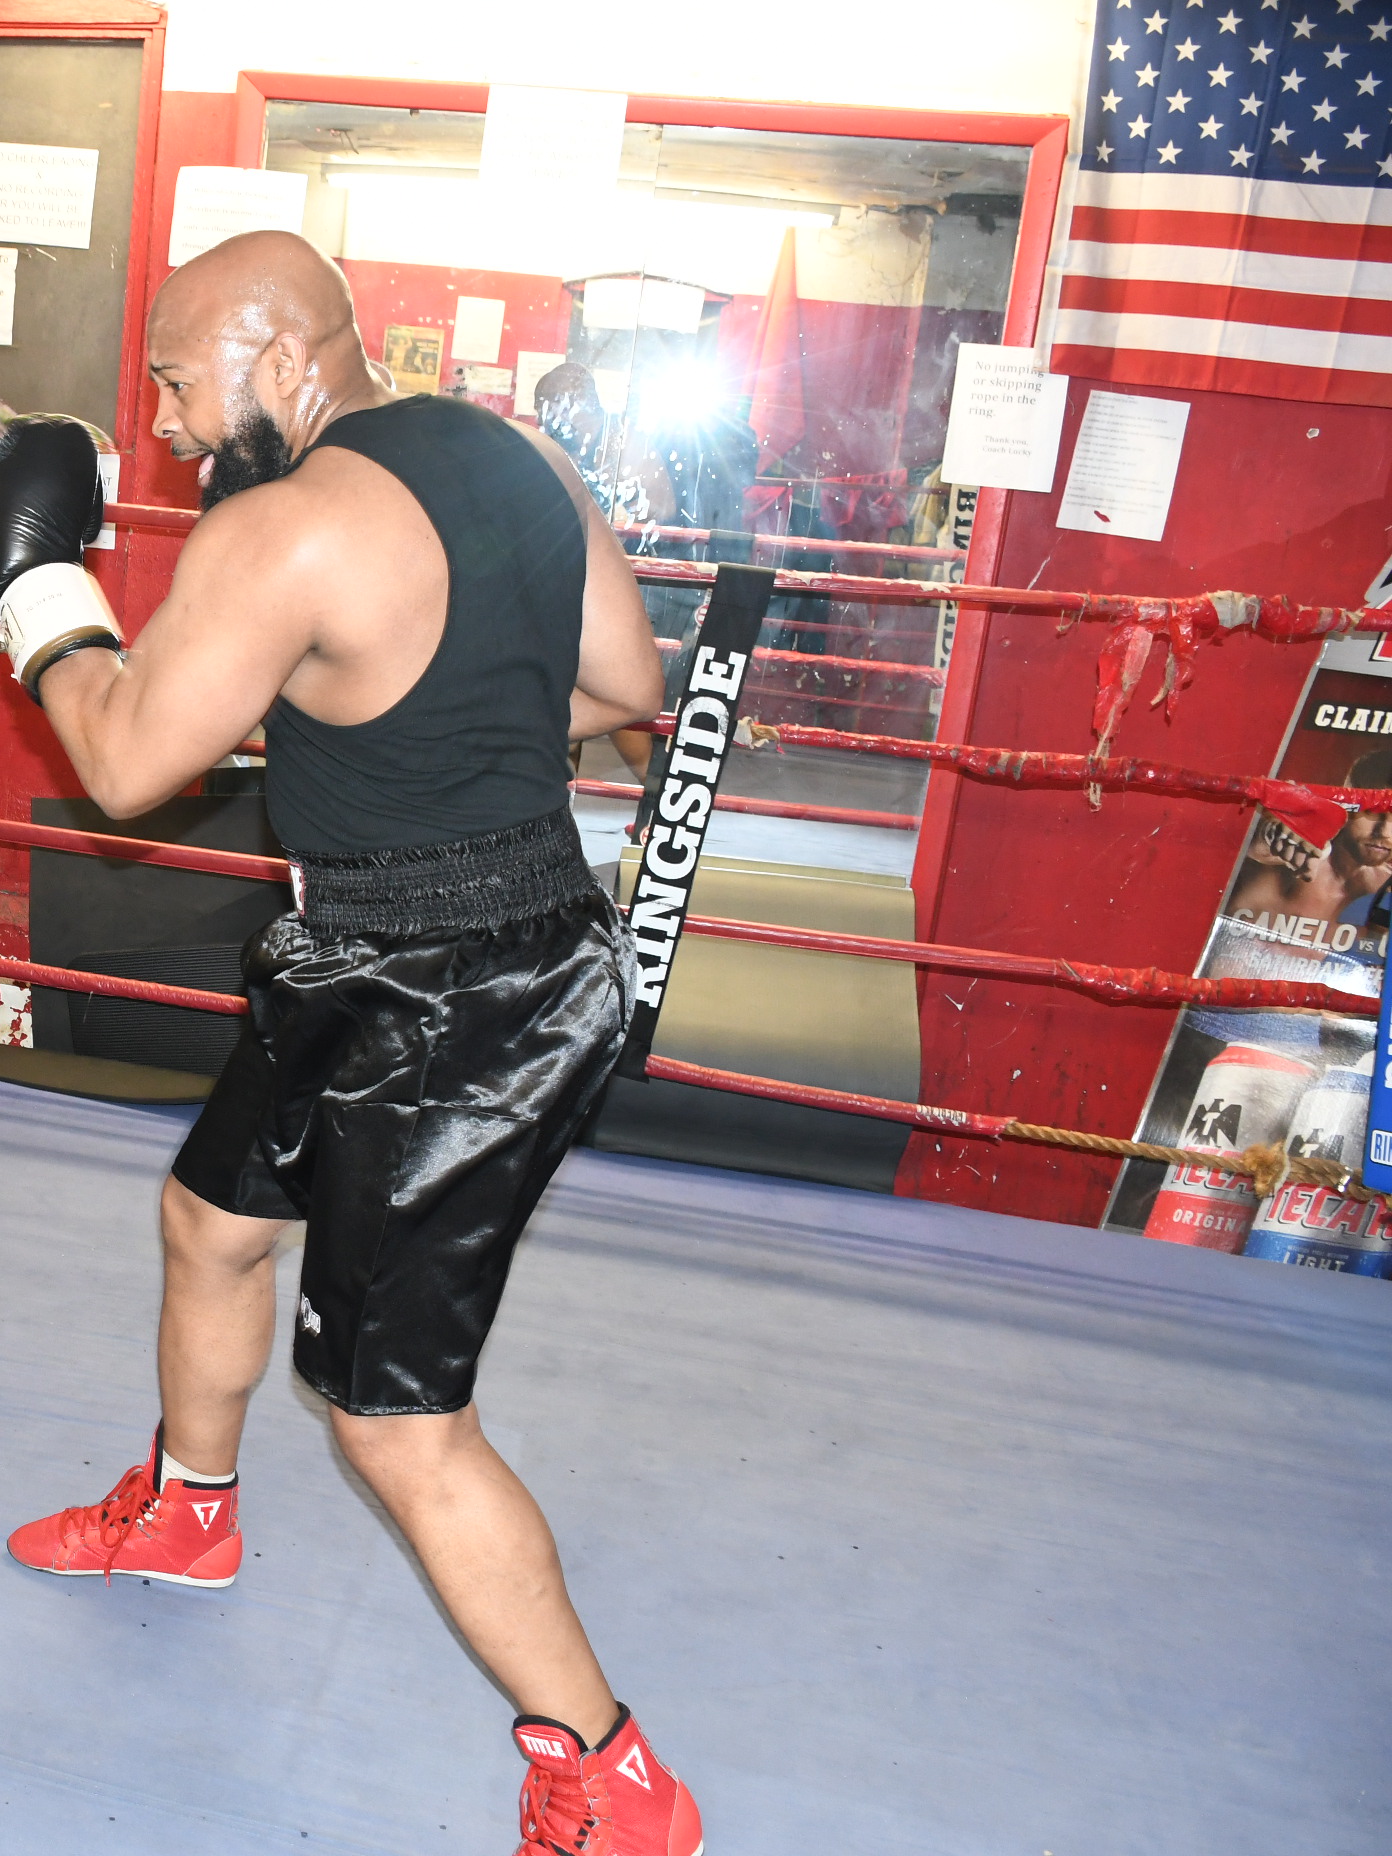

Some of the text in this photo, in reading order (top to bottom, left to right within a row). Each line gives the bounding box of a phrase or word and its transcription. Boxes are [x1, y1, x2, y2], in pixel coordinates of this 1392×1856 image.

[12, 200, 35, 210] YOU
[38, 202, 62, 213] WILL
[26, 216, 39, 226] TO
[975, 360, 1044, 379] No jumping
[973, 377, 1042, 393] or skipping
[971, 392, 1037, 406] rope in the
[968, 406, 996, 418] ring.
[986, 434, 1009, 445] Thank
[982, 444, 1032, 457] Coach Lucky
[635, 646, 747, 1009] RINGSIDE
[1229, 908, 1358, 952] CANELO
[1359, 940, 1375, 953] VS.
[1283, 1251, 1346, 1272] LIGHT
[520, 1734, 566, 1759] TITLE
